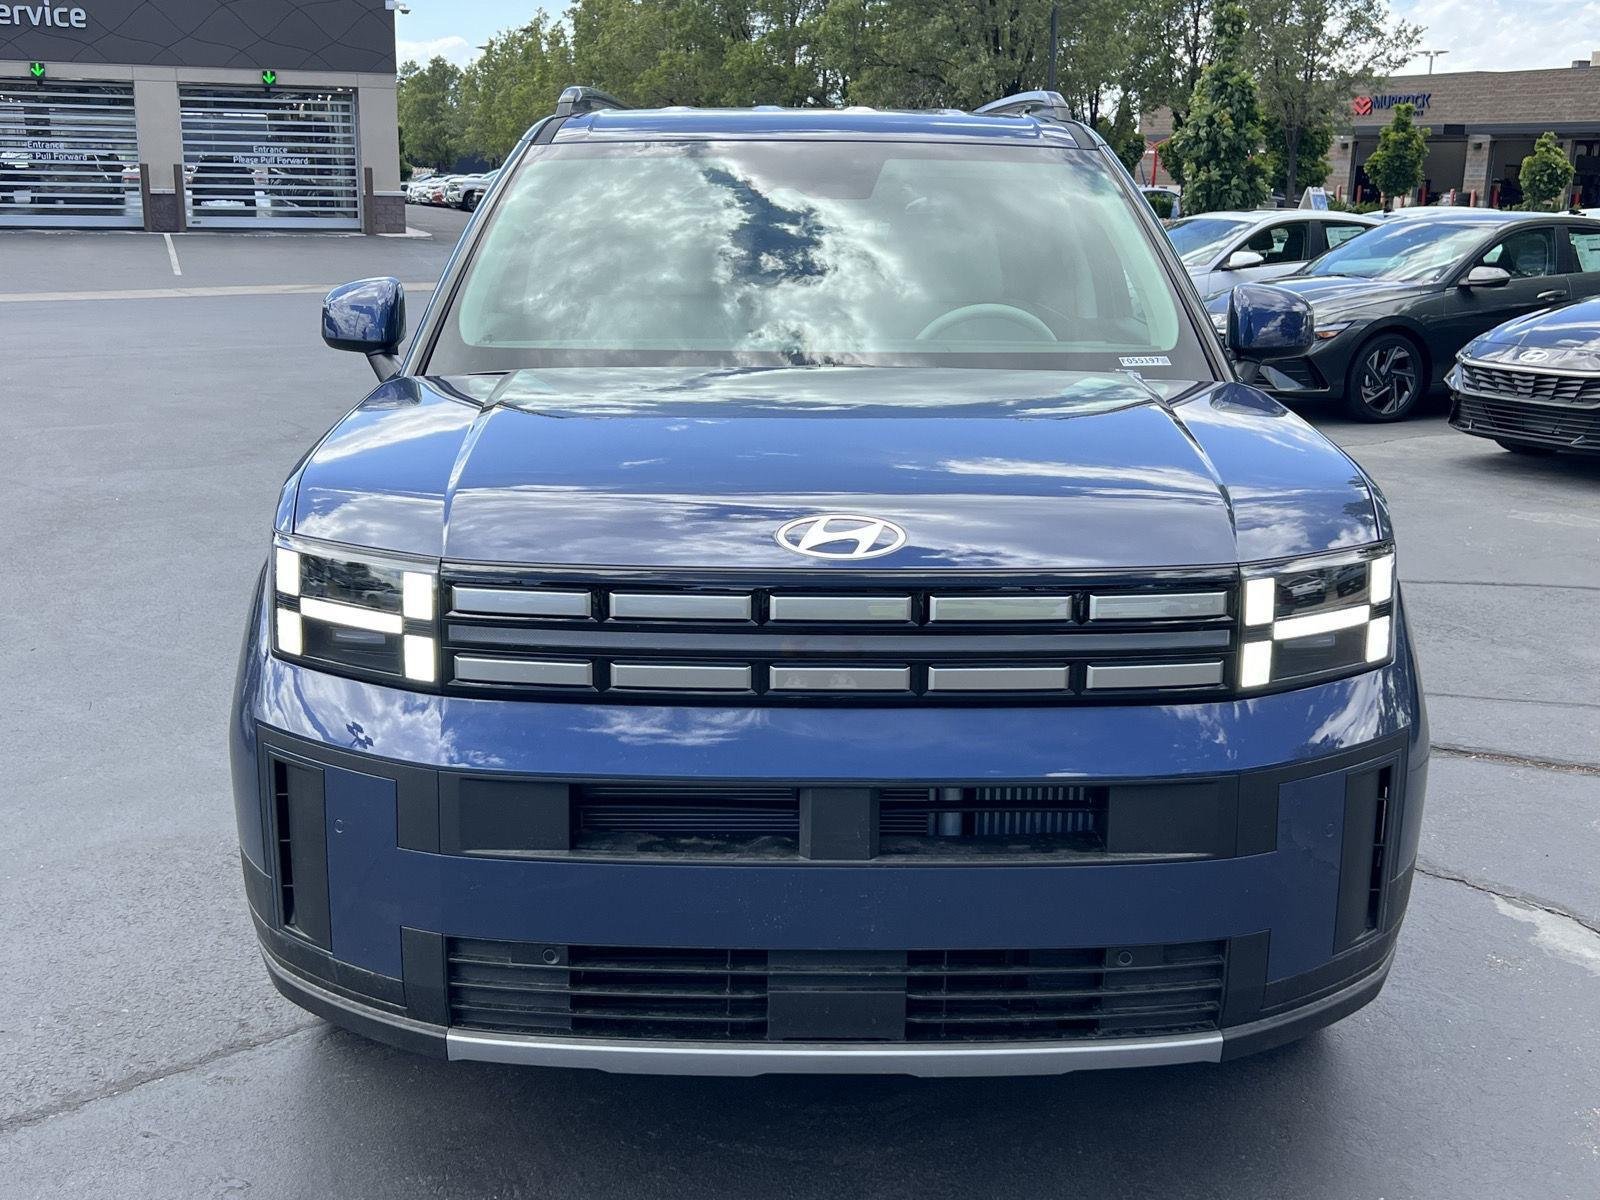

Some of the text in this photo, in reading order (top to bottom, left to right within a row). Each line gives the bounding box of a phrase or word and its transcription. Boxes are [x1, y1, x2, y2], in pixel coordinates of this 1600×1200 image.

[0, 0, 87, 28] ervice
[27, 140, 65, 149] Entrance
[253, 145, 288, 154] Entrance
[35, 152, 52, 160] Pull
[53, 152, 88, 161] Forward
[232, 154, 309, 165] Please Pull Forward
